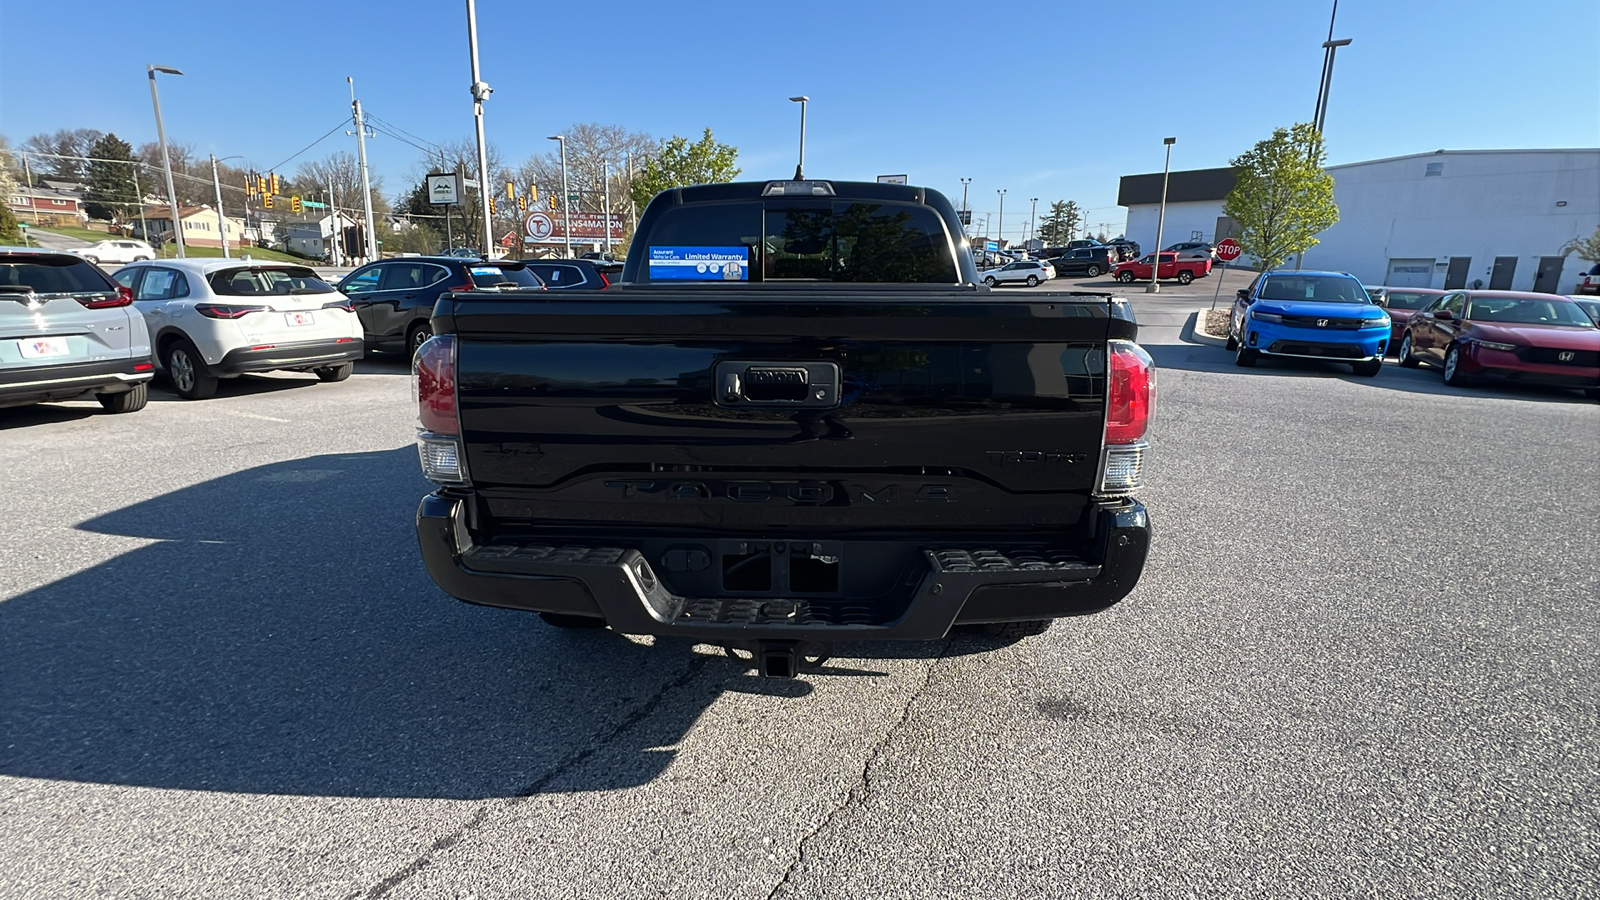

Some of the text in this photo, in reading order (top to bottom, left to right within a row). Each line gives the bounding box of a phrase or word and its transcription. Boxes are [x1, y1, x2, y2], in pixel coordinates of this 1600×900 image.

[554, 219, 623, 228] TRNS4MATON
[1217, 244, 1240, 255] STOP
[750, 370, 805, 383] TOYOTA
[605, 478, 959, 503] TACOMA
